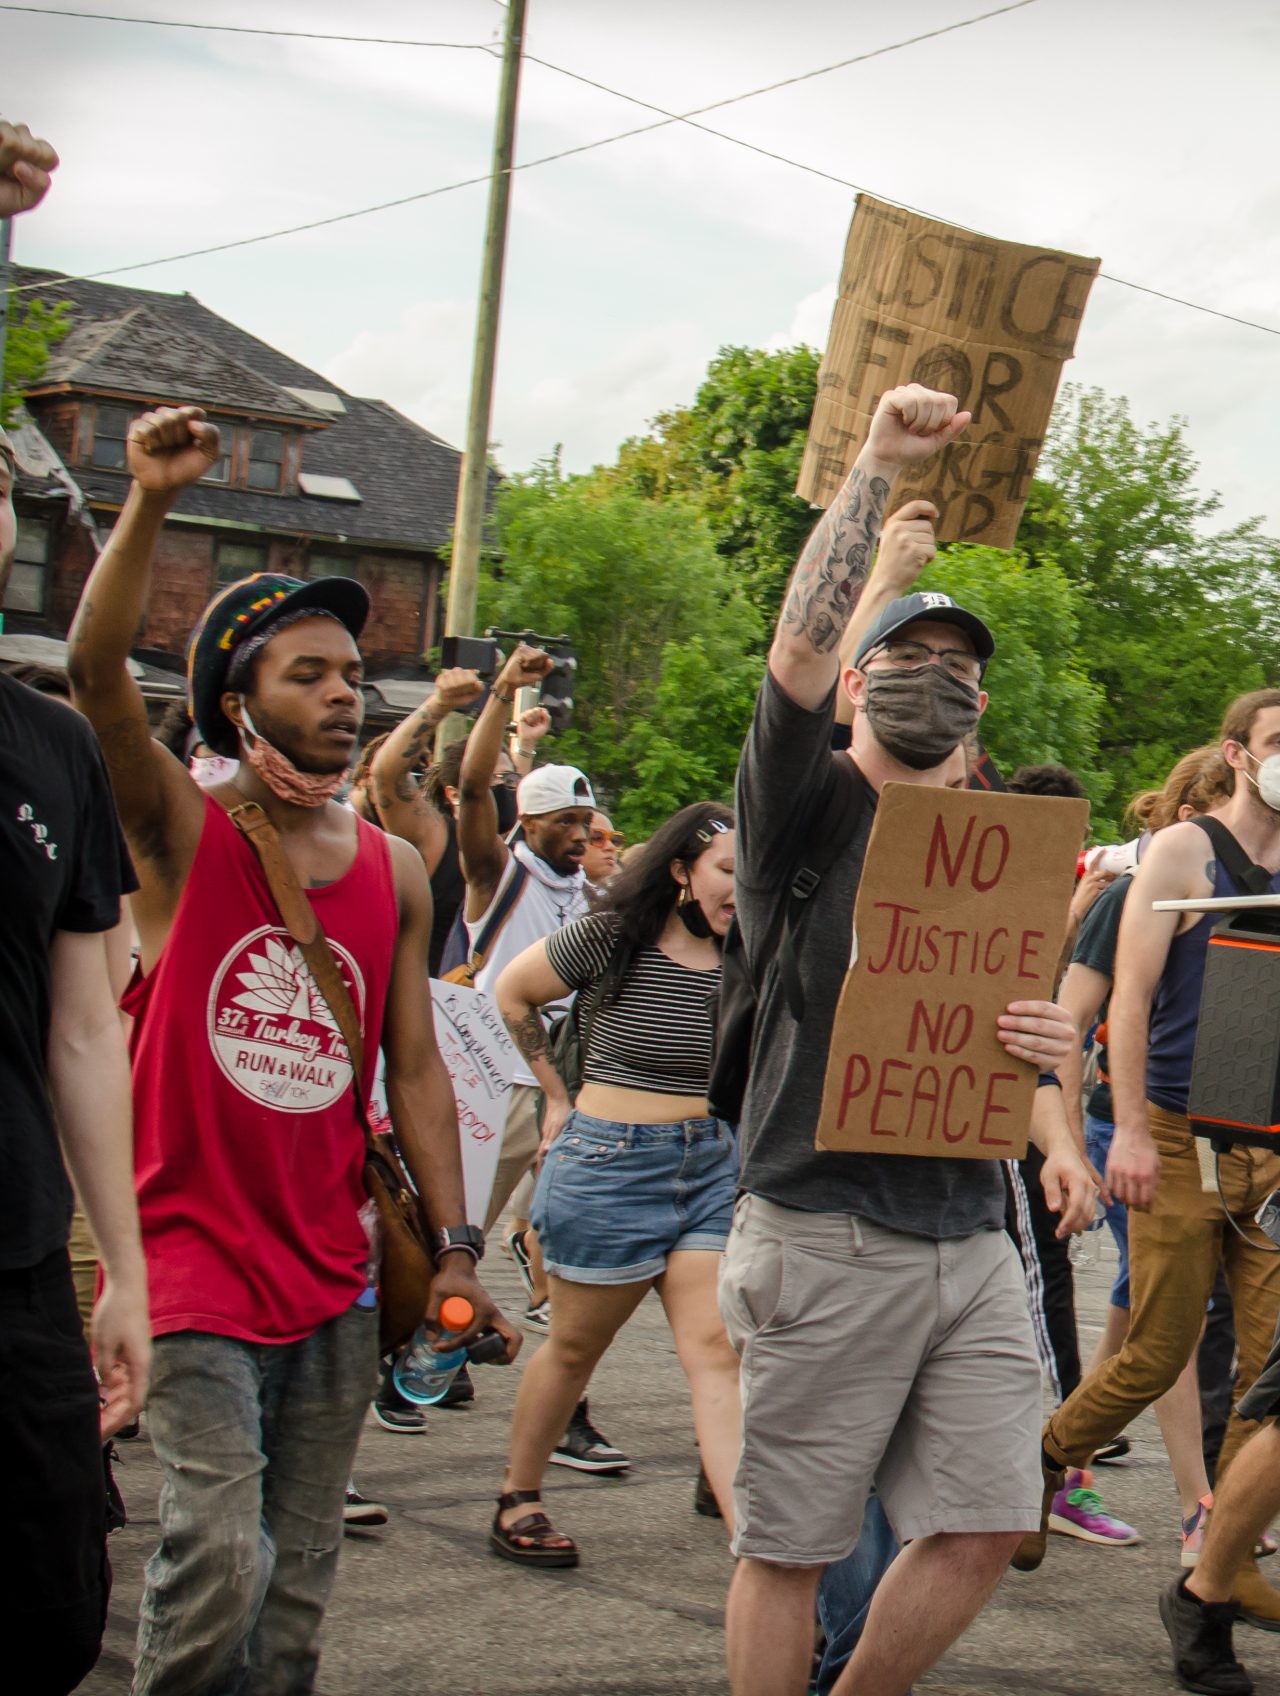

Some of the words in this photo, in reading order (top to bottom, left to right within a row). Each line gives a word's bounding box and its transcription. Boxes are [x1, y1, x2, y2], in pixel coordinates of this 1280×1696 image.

[846, 205, 1100, 357] JUSTICE
[850, 319, 1024, 432] FOR
[924, 813, 1010, 892] NO
[867, 902, 1045, 979] JUSTICE
[252, 1014, 322, 1063] Turkey
[906, 1000, 974, 1055] NO
[235, 1050, 279, 1075] RUN
[279, 1063, 288, 1076] &
[289, 1062, 337, 1089] WALK
[836, 1053, 1019, 1146] PEACE
